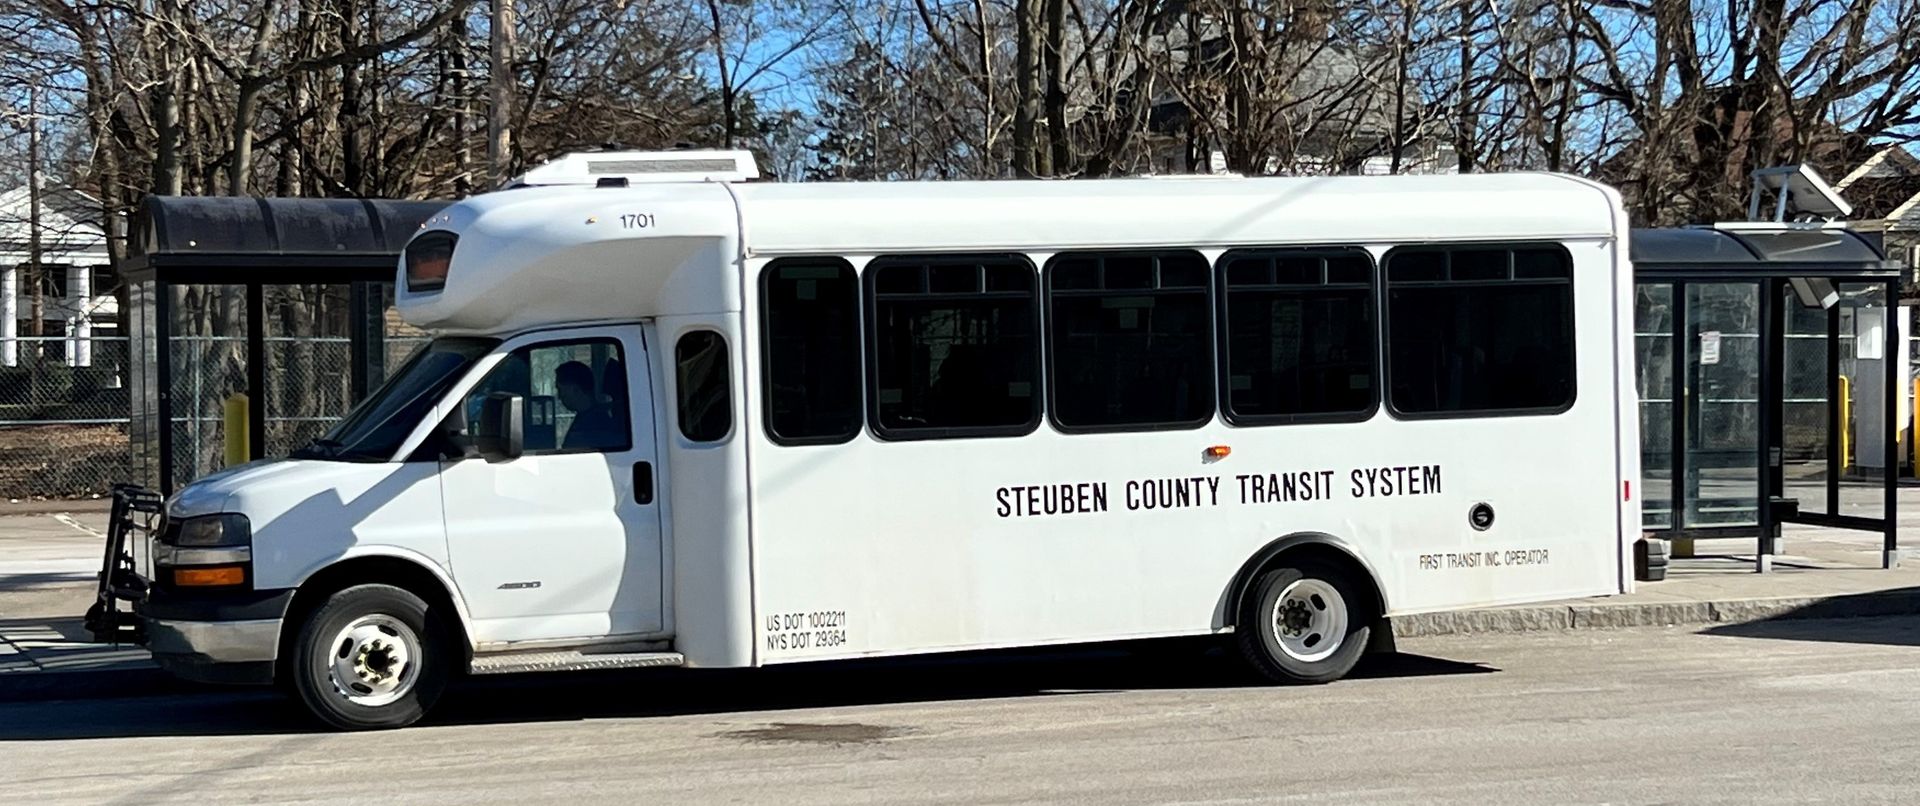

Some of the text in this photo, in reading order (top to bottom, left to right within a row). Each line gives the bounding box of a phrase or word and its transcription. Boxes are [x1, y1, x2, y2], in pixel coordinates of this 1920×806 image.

[619, 213, 655, 229] 1701
[996, 465, 1442, 518] STEUBEN COUNTY TRANSIT SYSTEM
[1419, 549, 1549, 570] FIRST TRANSIT INC. OPERATOR
[766, 610, 846, 631] US DOT 1002211
[767, 629, 846, 650] NYS DOT 29364
